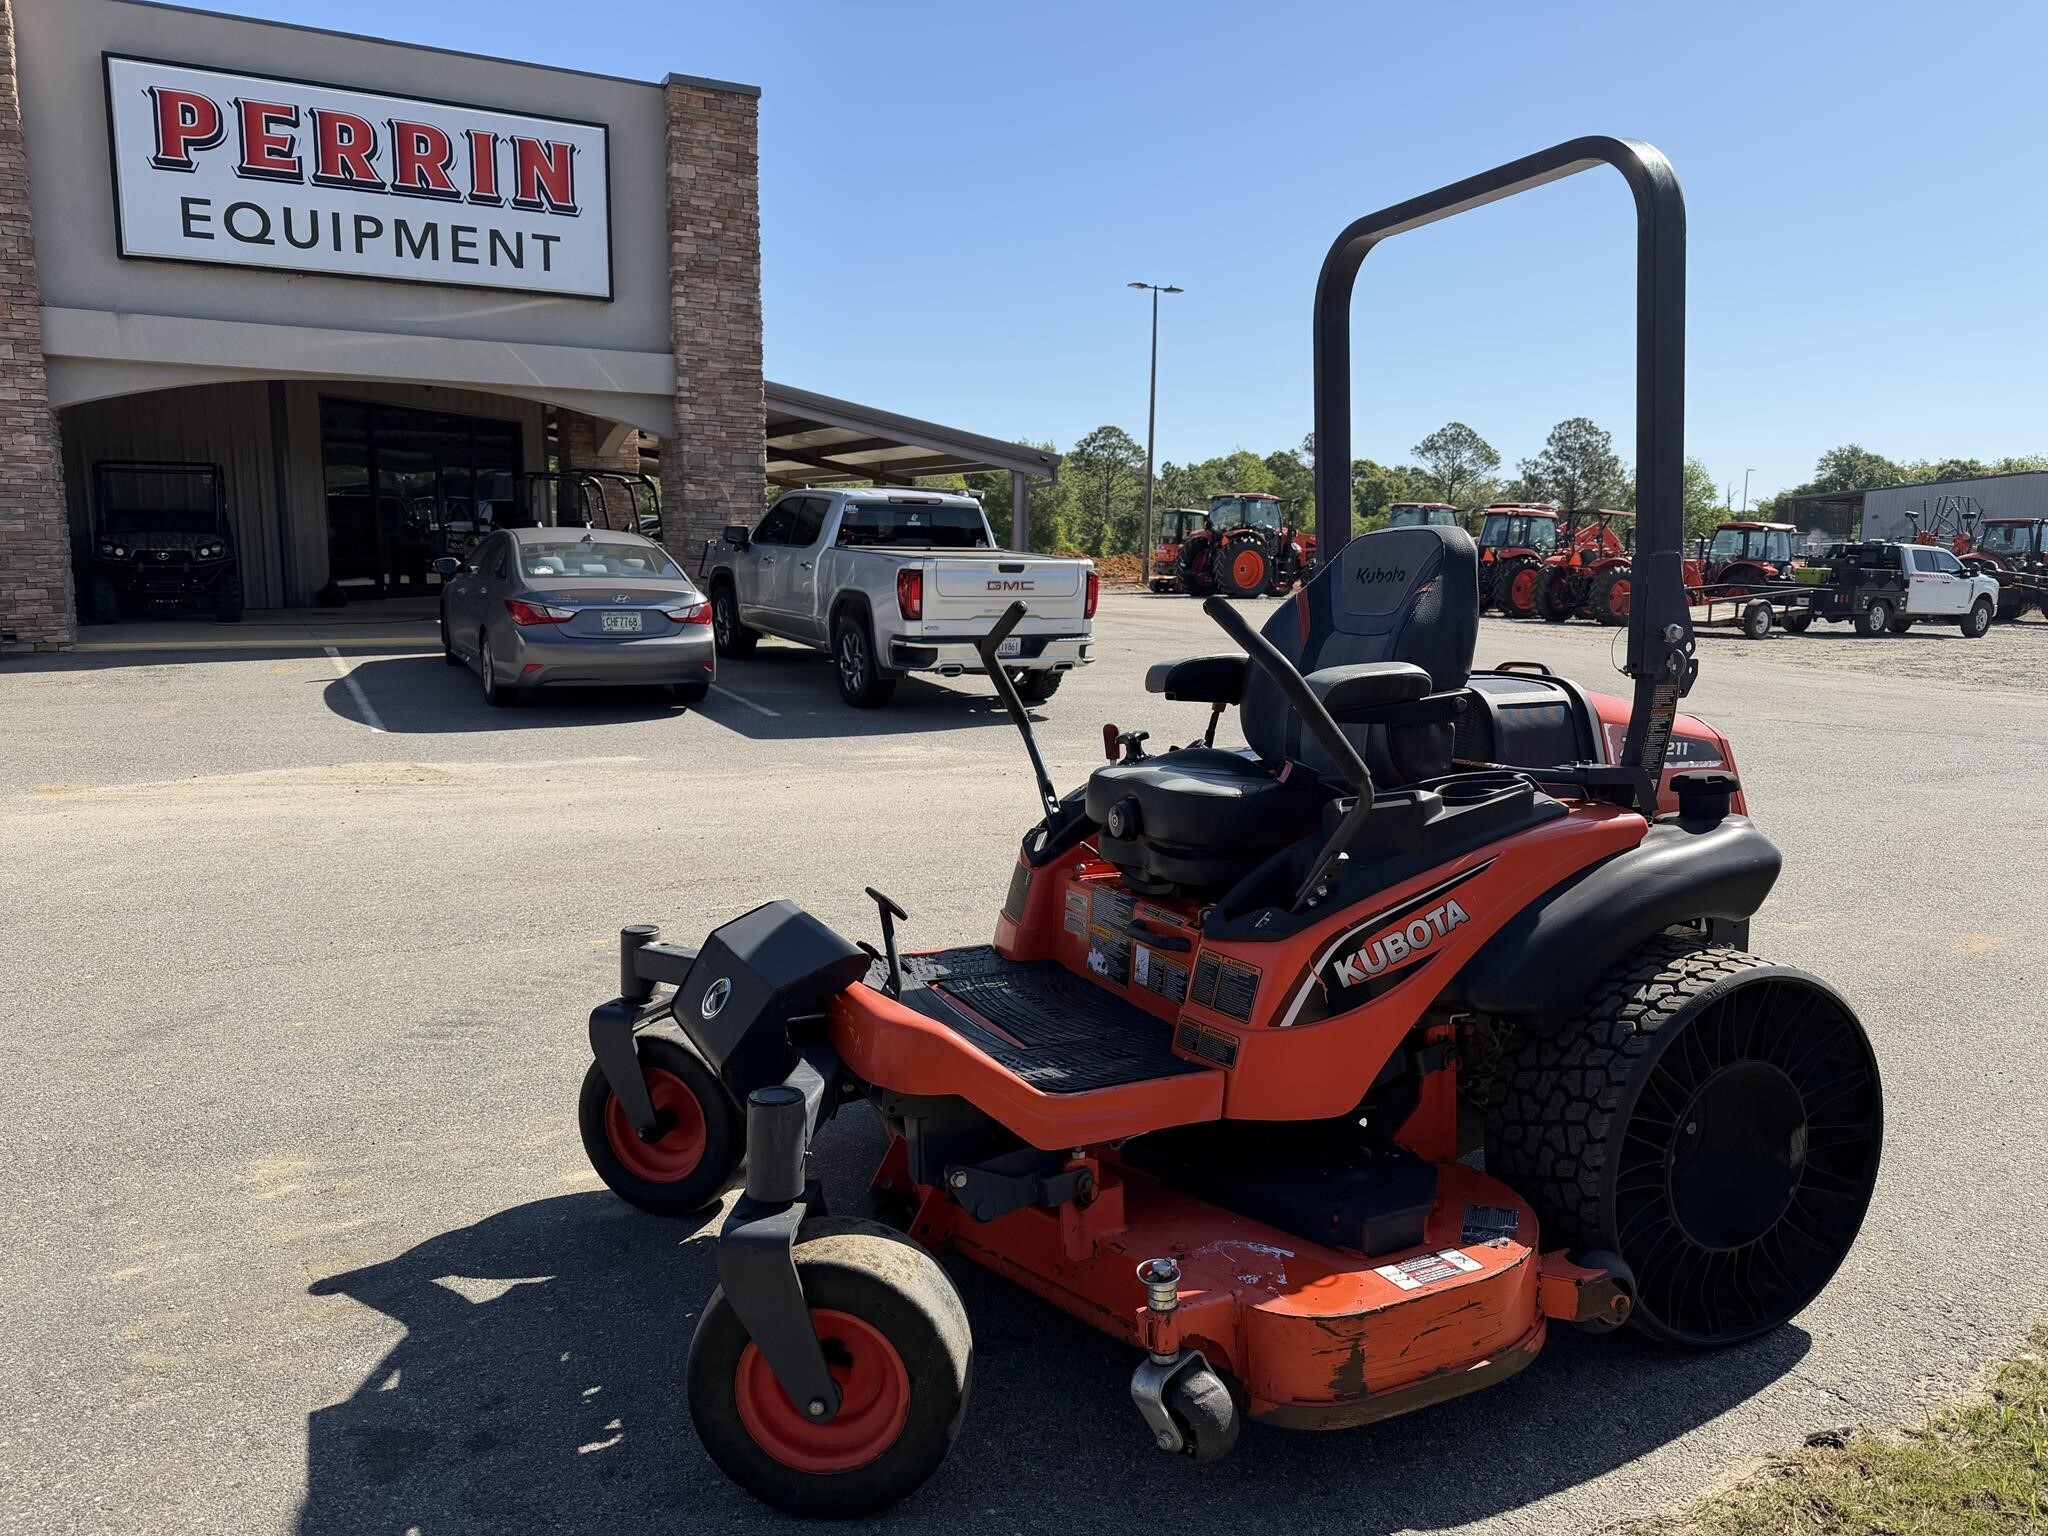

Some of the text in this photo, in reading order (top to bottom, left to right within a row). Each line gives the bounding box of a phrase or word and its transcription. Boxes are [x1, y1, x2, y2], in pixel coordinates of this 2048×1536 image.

[146, 85, 583, 216] PERRIN
[180, 196, 561, 272] EQUIPMENT
[987, 581, 1035, 591] GMC
[1356, 565, 1405, 584] Kubota
[1333, 898, 1471, 989] KUBOTA
